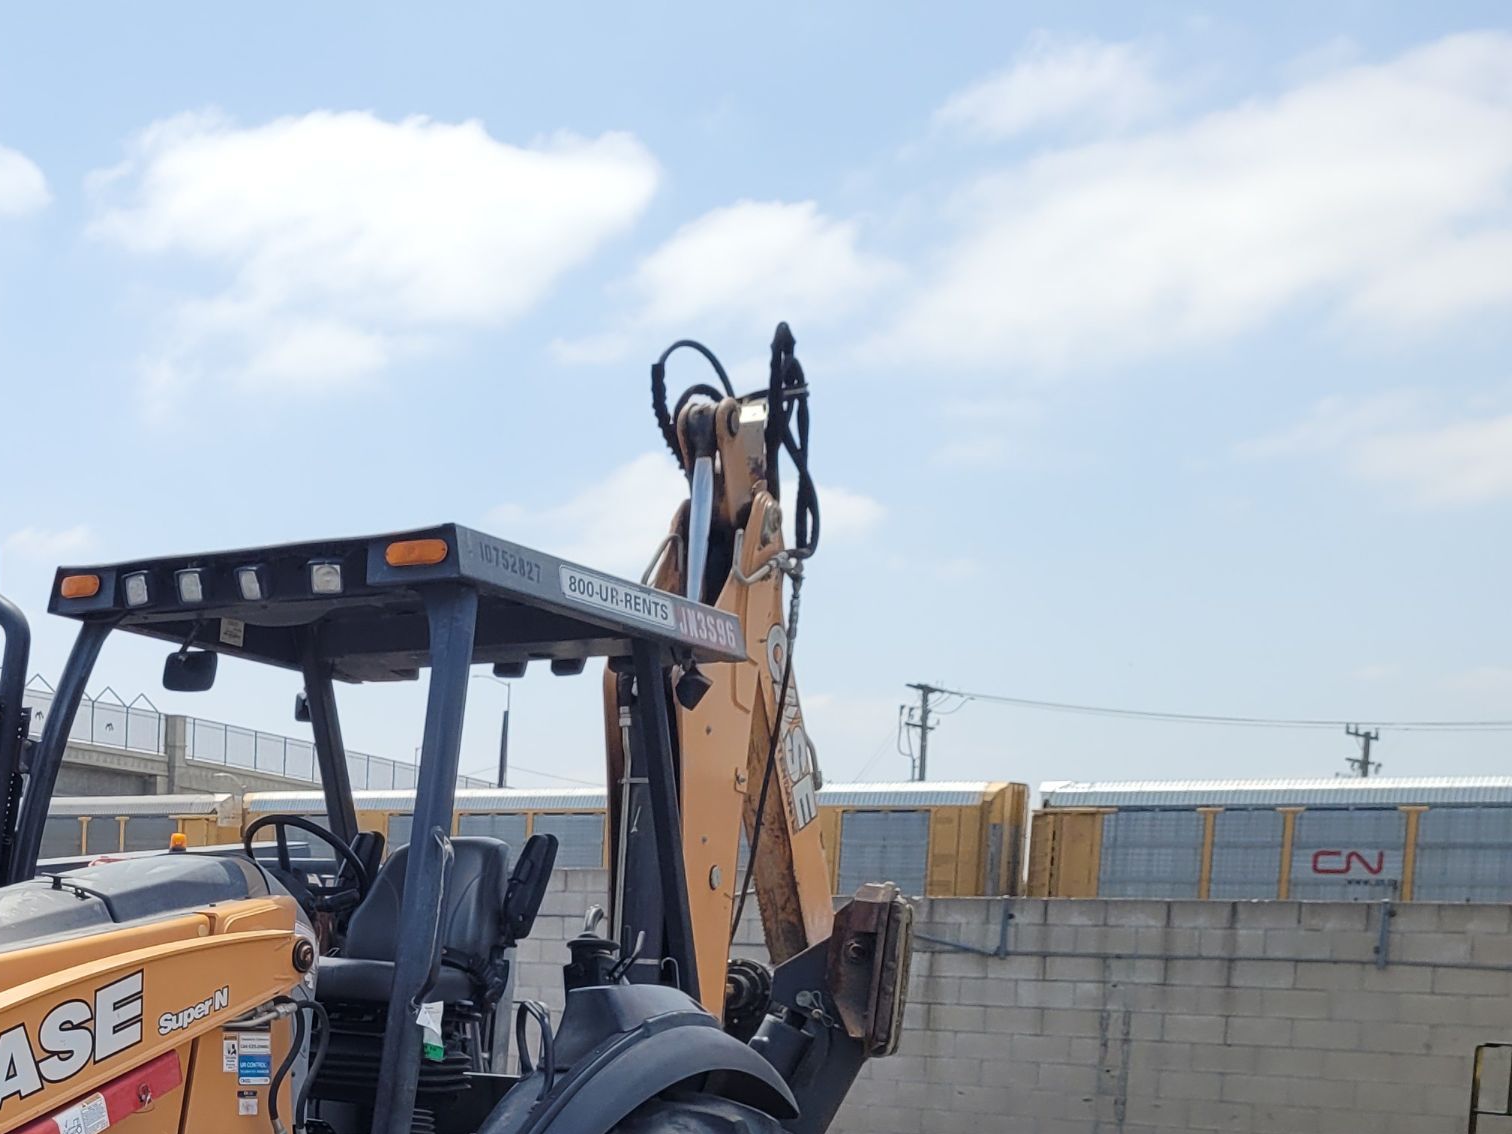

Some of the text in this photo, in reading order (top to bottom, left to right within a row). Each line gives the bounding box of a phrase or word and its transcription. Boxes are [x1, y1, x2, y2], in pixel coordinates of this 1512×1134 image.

[479, 541, 541, 584] 10752827
[568, 574, 669, 621] 800-UR-RENTS
[679, 606, 737, 649] JN3S96
[1312, 850, 1385, 875] CN
[158, 985, 229, 1036] Super N
